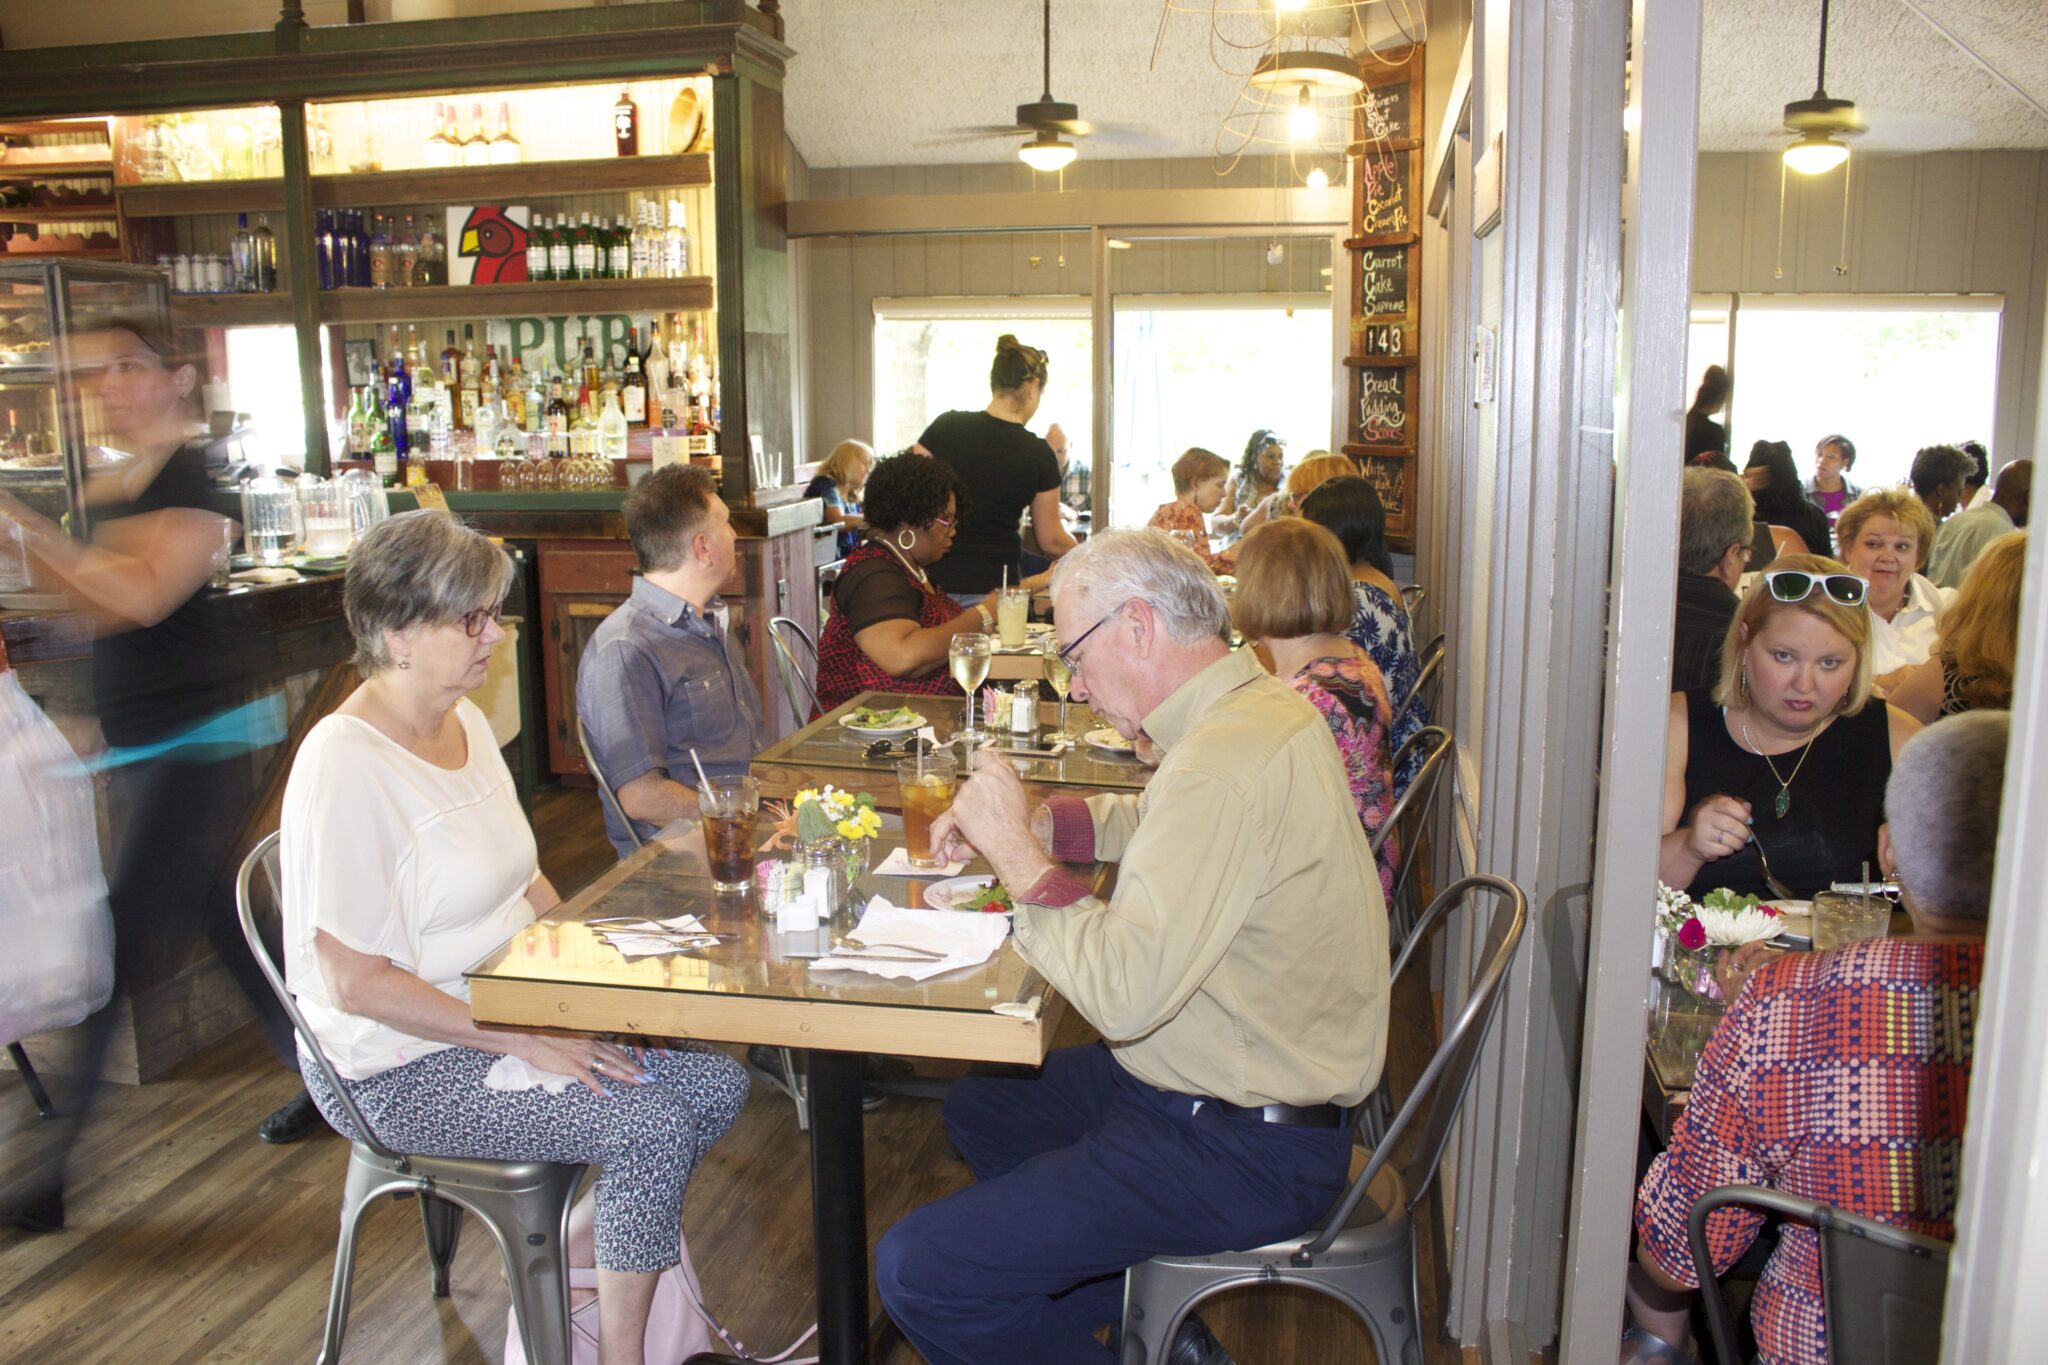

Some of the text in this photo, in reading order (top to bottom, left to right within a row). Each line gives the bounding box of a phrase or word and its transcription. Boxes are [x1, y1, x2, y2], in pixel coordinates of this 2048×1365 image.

[1375, 121, 1400, 136] Cake
[1364, 155, 1394, 183] Apple
[1366, 180, 1385, 204] Pie
[1368, 183, 1403, 216] Coconut
[1363, 205, 1409, 234] Cream Pie
[1363, 250, 1403, 271] Carrot
[1364, 271, 1394, 297] Cake
[1362, 294, 1406, 318] Supreme
[505, 314, 637, 374] PUB
[1362, 370, 1401, 396] Bread
[1360, 395, 1402, 423] Pudding
[1363, 416, 1404, 441] Scones
